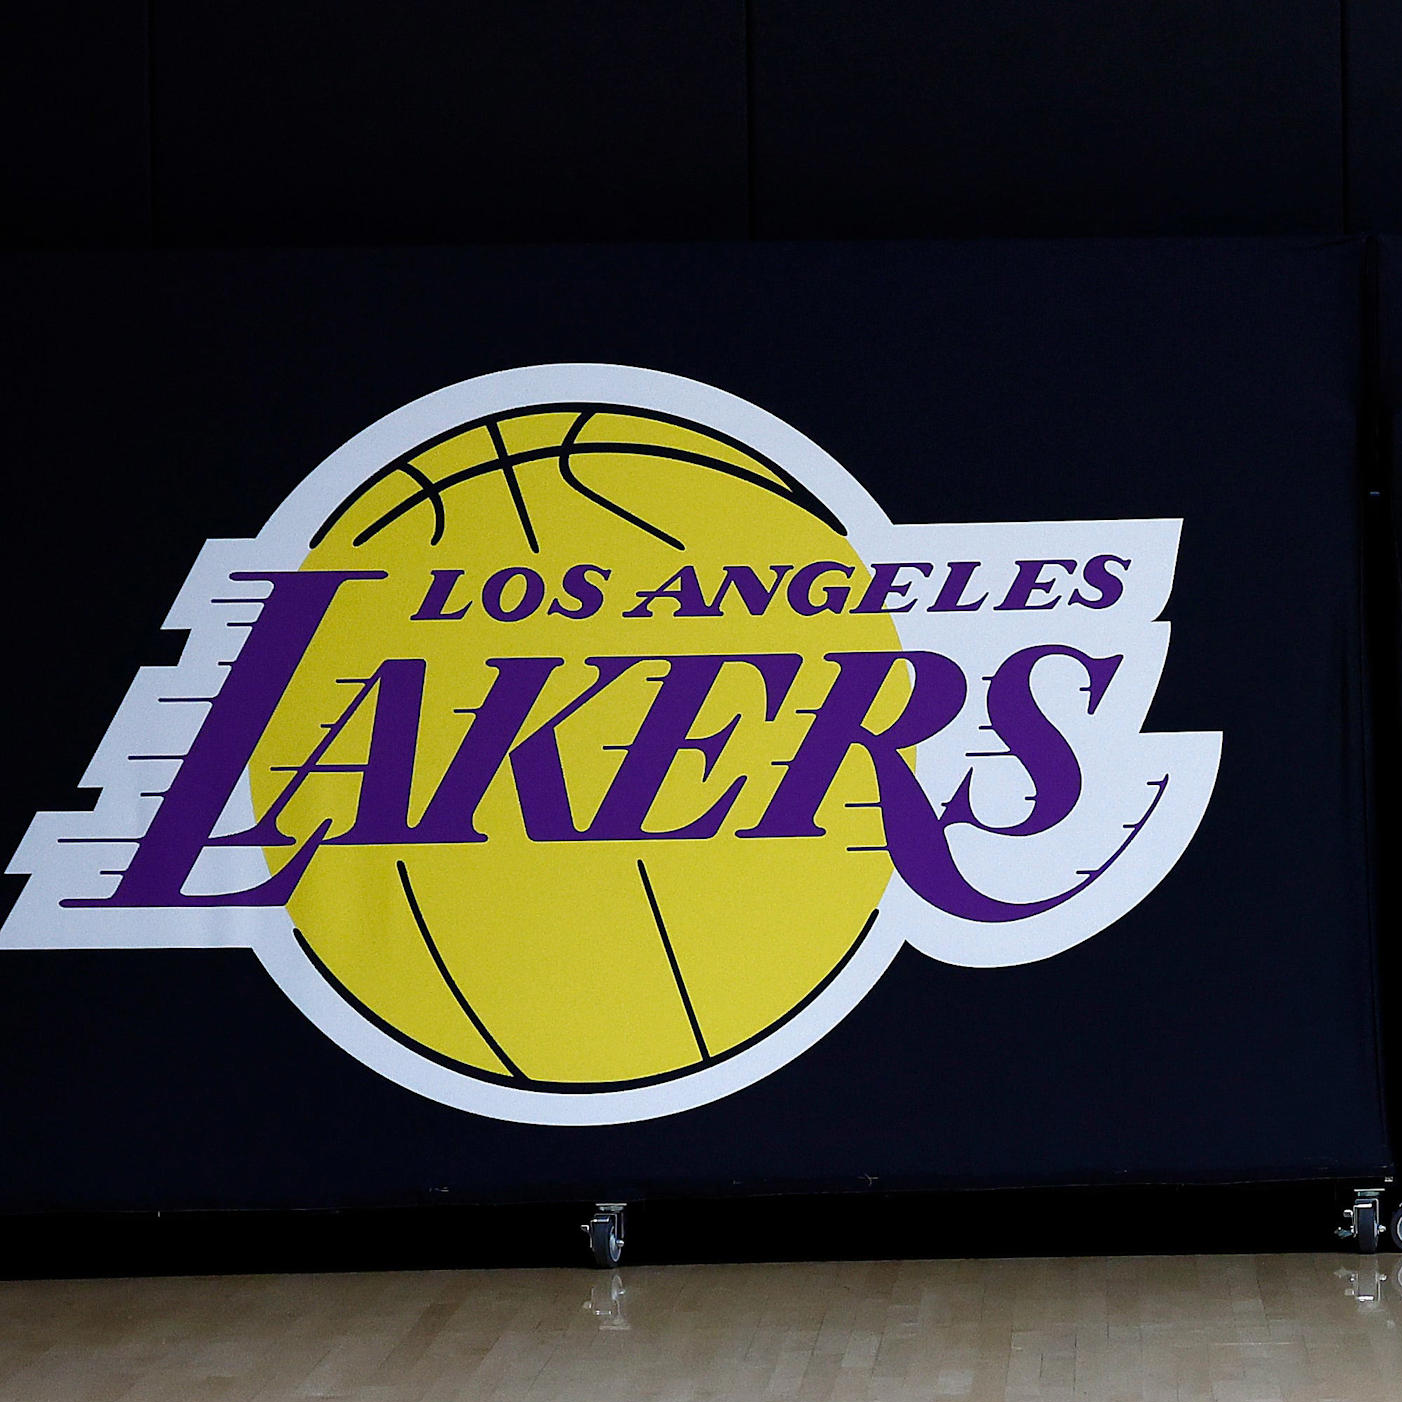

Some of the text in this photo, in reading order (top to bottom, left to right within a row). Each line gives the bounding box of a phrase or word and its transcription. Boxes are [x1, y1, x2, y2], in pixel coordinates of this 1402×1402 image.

[412, 554, 1130, 621] LOS ANGELES
[60, 570, 1169, 923] LAKERS
